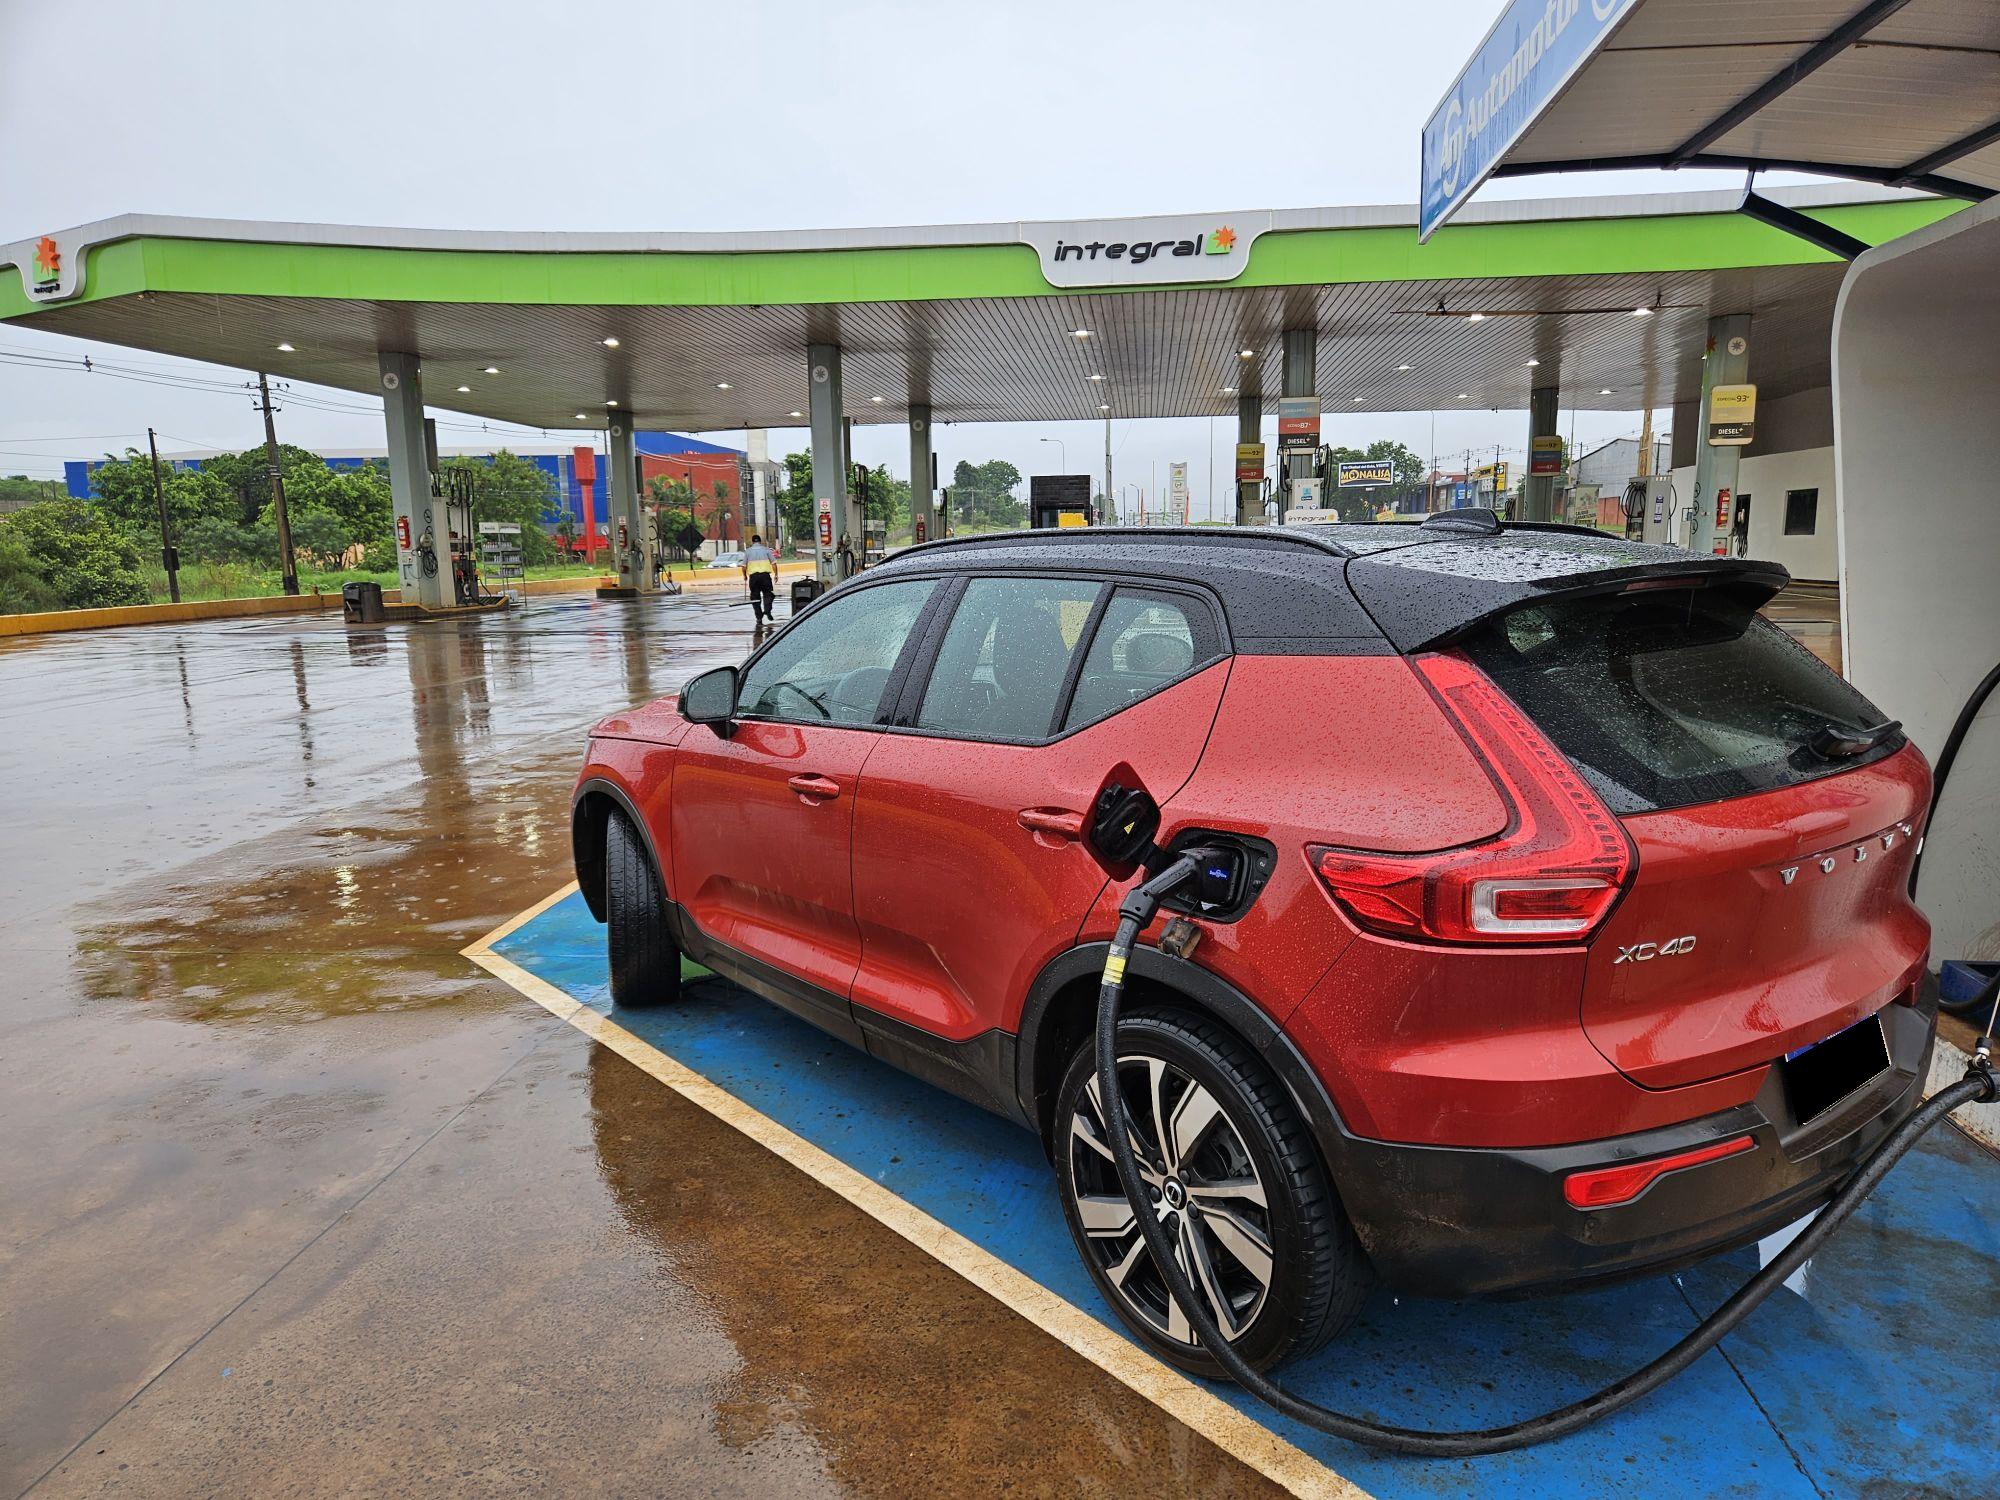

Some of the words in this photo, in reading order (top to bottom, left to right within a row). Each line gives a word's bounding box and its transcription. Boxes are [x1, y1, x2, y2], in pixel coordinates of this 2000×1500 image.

[1054, 233, 1204, 264] integral
[1340, 468, 1391, 480] MONALISA
[1780, 824, 1912, 885] VOLVO
